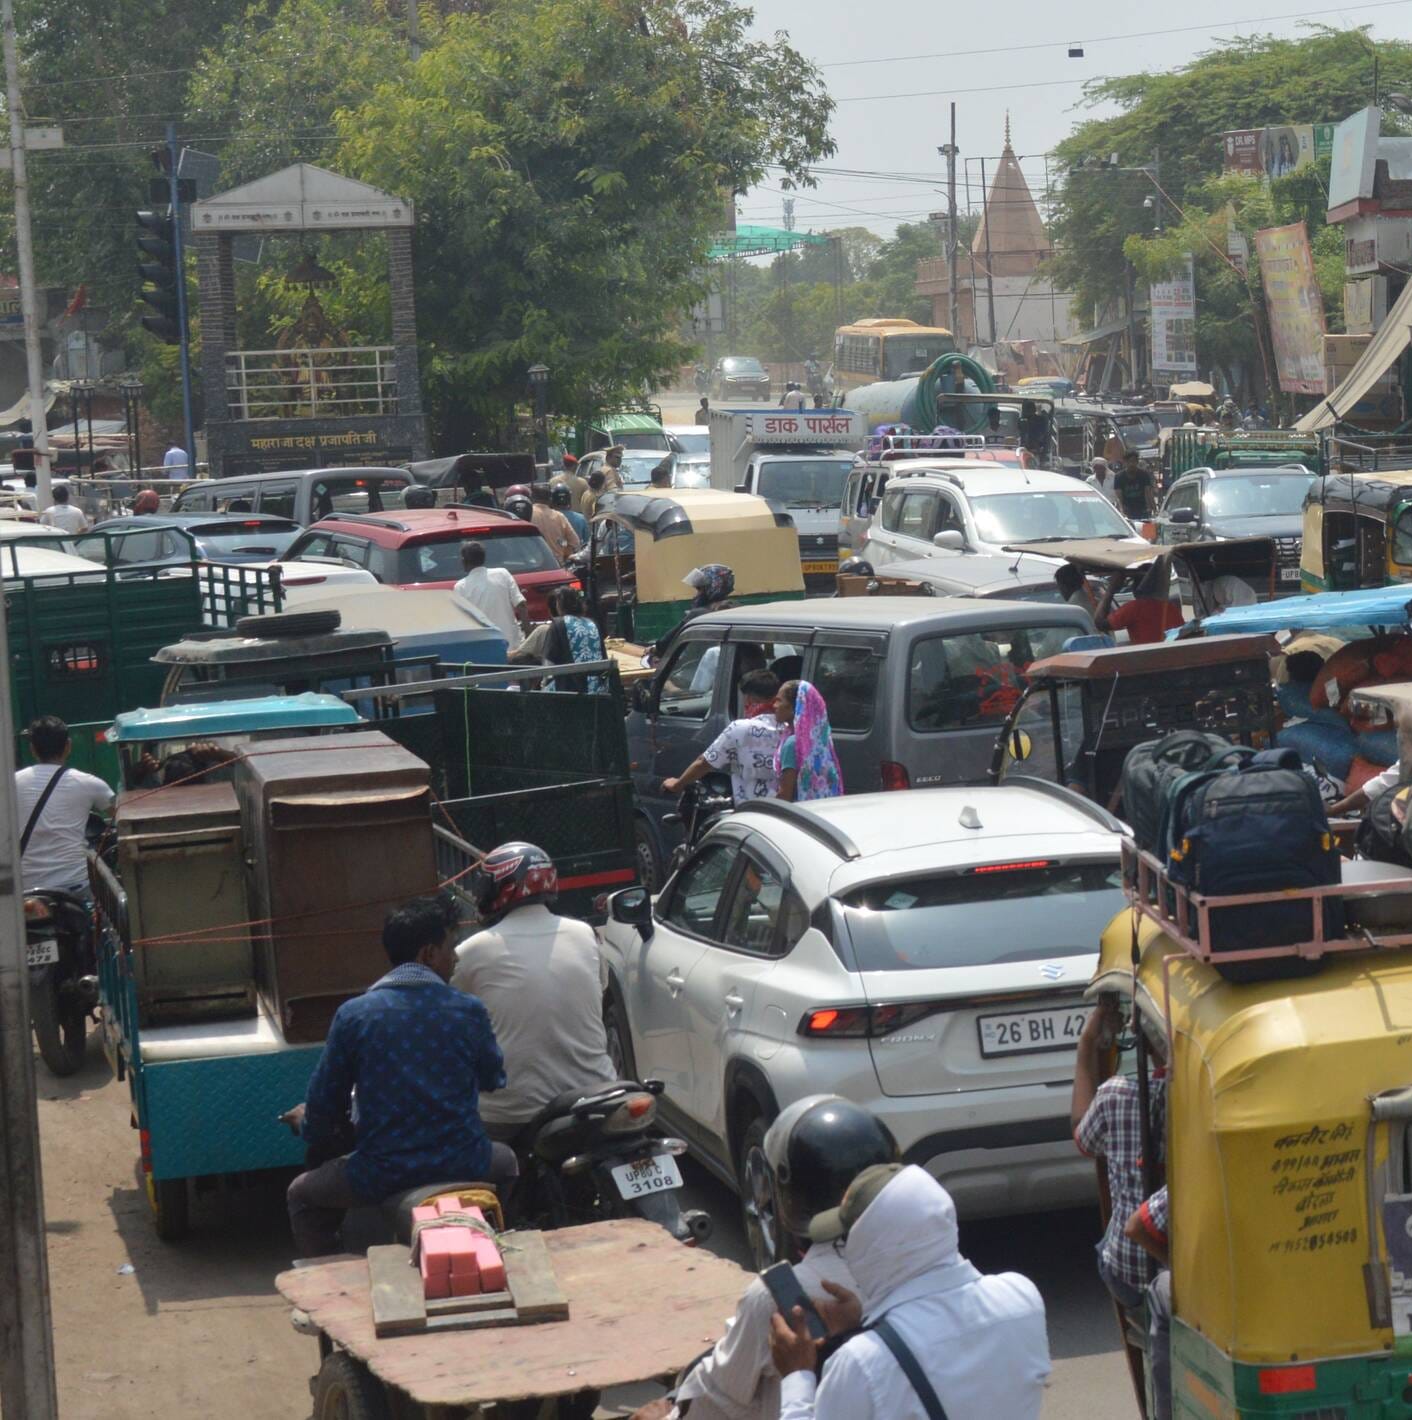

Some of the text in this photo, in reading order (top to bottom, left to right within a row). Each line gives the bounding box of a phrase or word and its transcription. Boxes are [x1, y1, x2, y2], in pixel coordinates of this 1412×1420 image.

[764, 414, 853, 434] डाक पार्सल
[996, 1015, 1086, 1045] 26 BH 42
[631, 1175, 674, 1194] 3108
